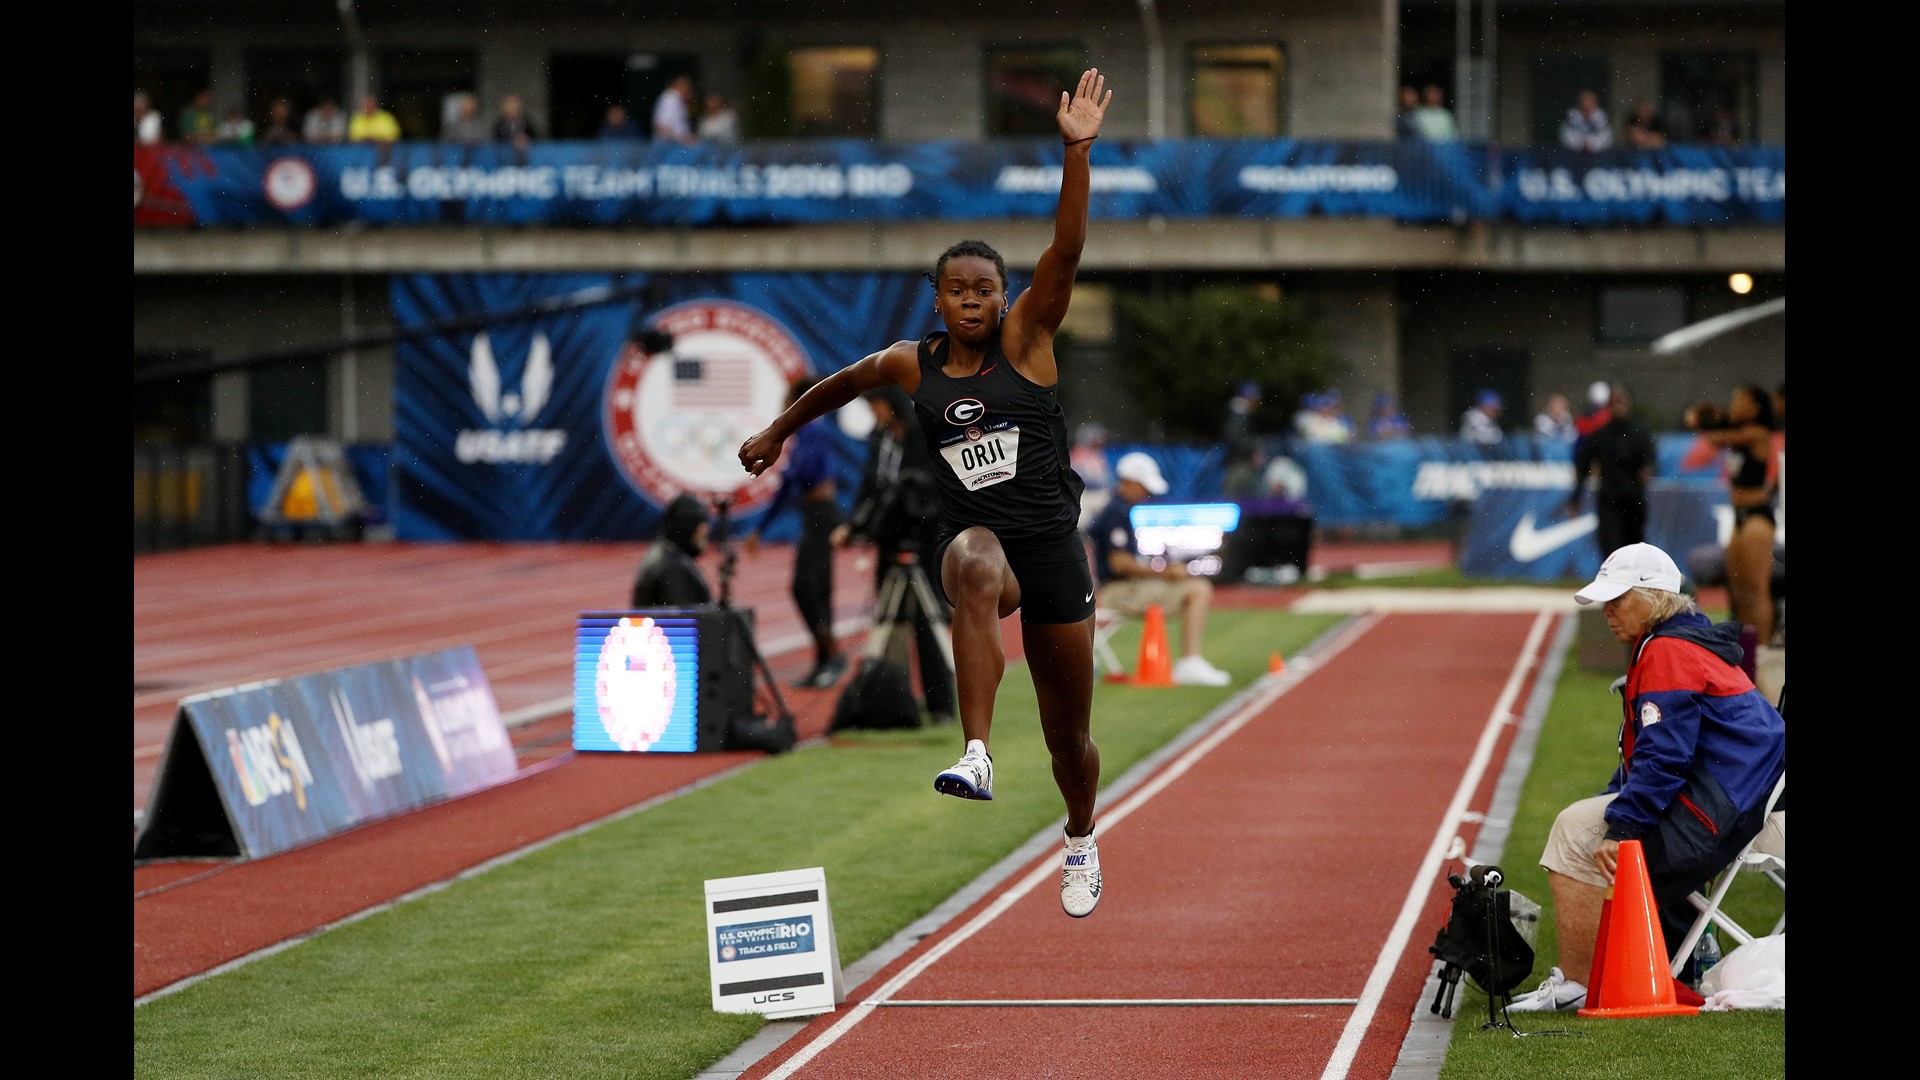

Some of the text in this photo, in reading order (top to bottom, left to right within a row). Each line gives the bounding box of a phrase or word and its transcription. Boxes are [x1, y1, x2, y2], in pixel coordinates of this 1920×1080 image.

[407, 166, 558, 199] OLYMPIC
[564, 165, 653, 199] TEAM
[656, 164, 762, 198] TRIALS
[1584, 167, 1730, 200] OLYMPIC
[961, 438, 1006, 471] ORJI
[1065, 854, 1087, 866] NIKE
[737, 928, 775, 939] OLYMPIC
[781, 923, 810, 939] RIO
[739, 942, 798, 955] TRACK & FIELD
[753, 992, 795, 1004] UCS
